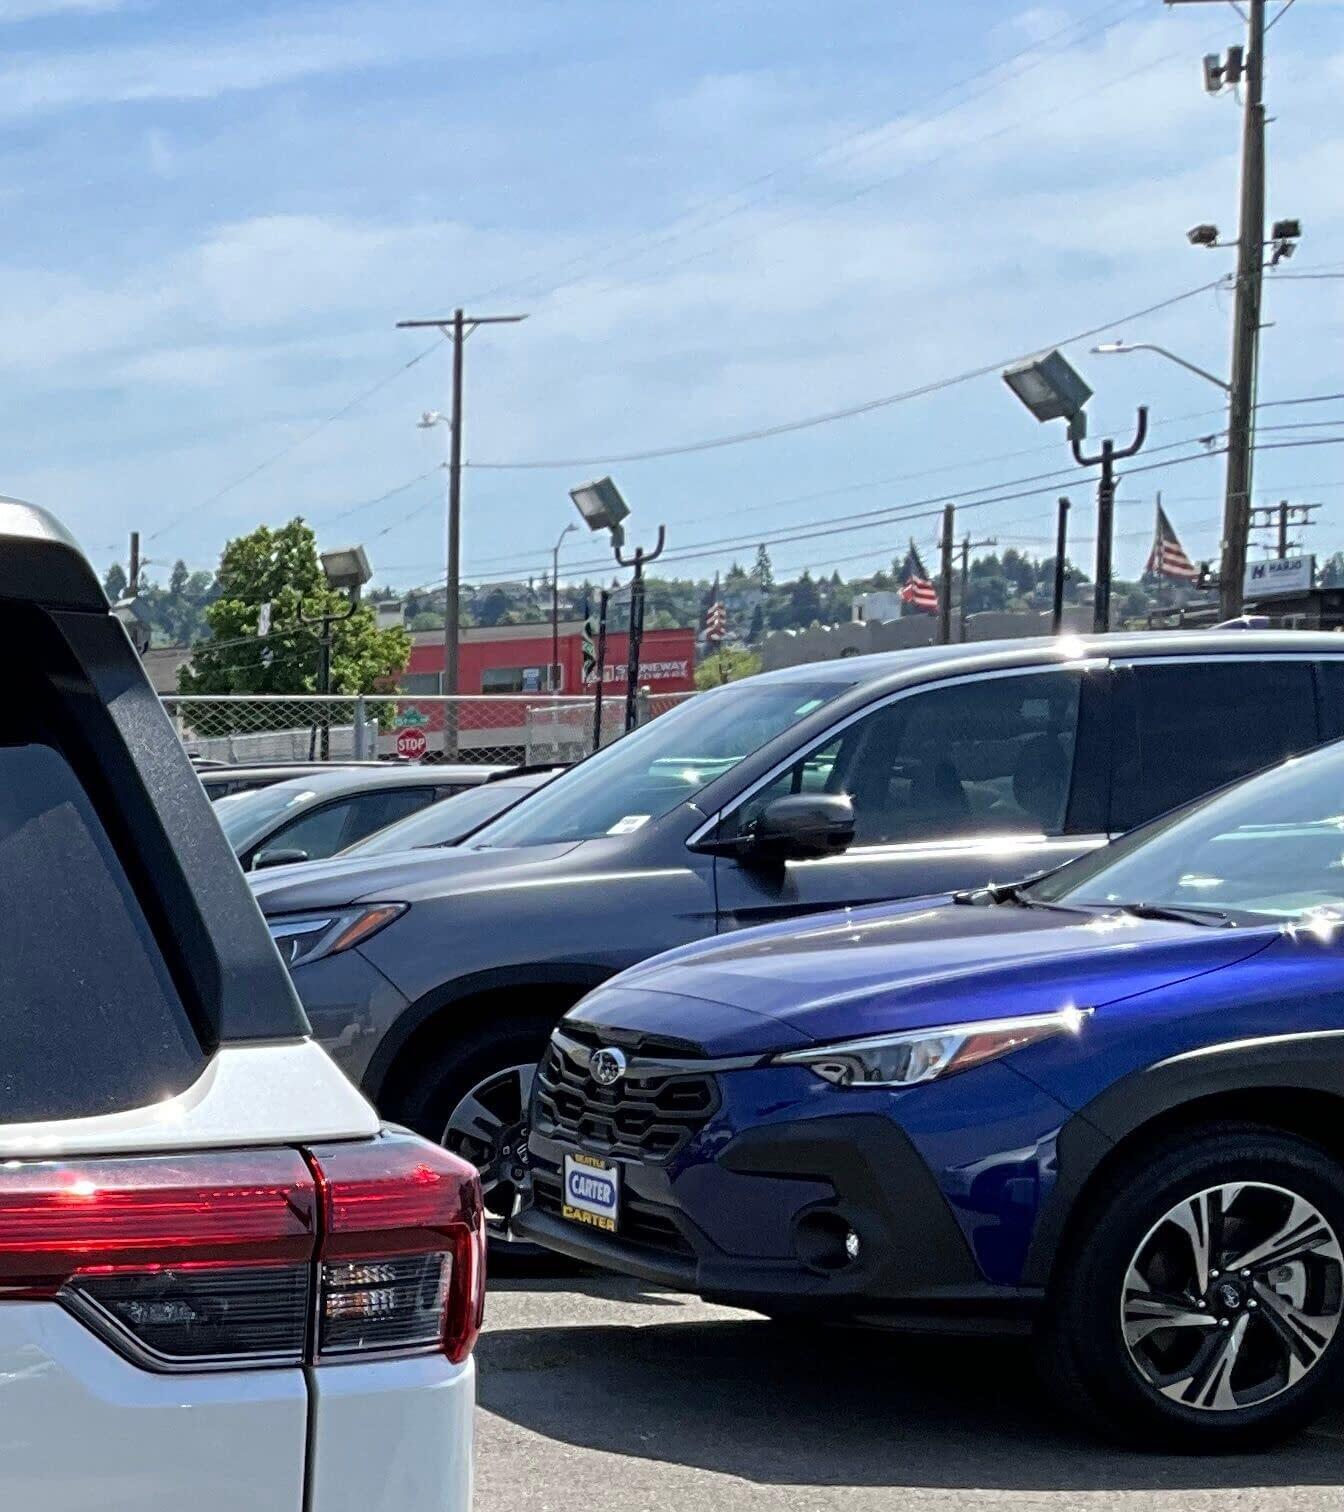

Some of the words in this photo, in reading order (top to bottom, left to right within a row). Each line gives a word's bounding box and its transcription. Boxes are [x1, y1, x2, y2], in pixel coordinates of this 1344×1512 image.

[615, 661, 688, 675] SNEWAY
[398, 738, 425, 751] STOP
[572, 1173, 612, 1204] CARTER
[562, 1205, 615, 1232] CARTER
